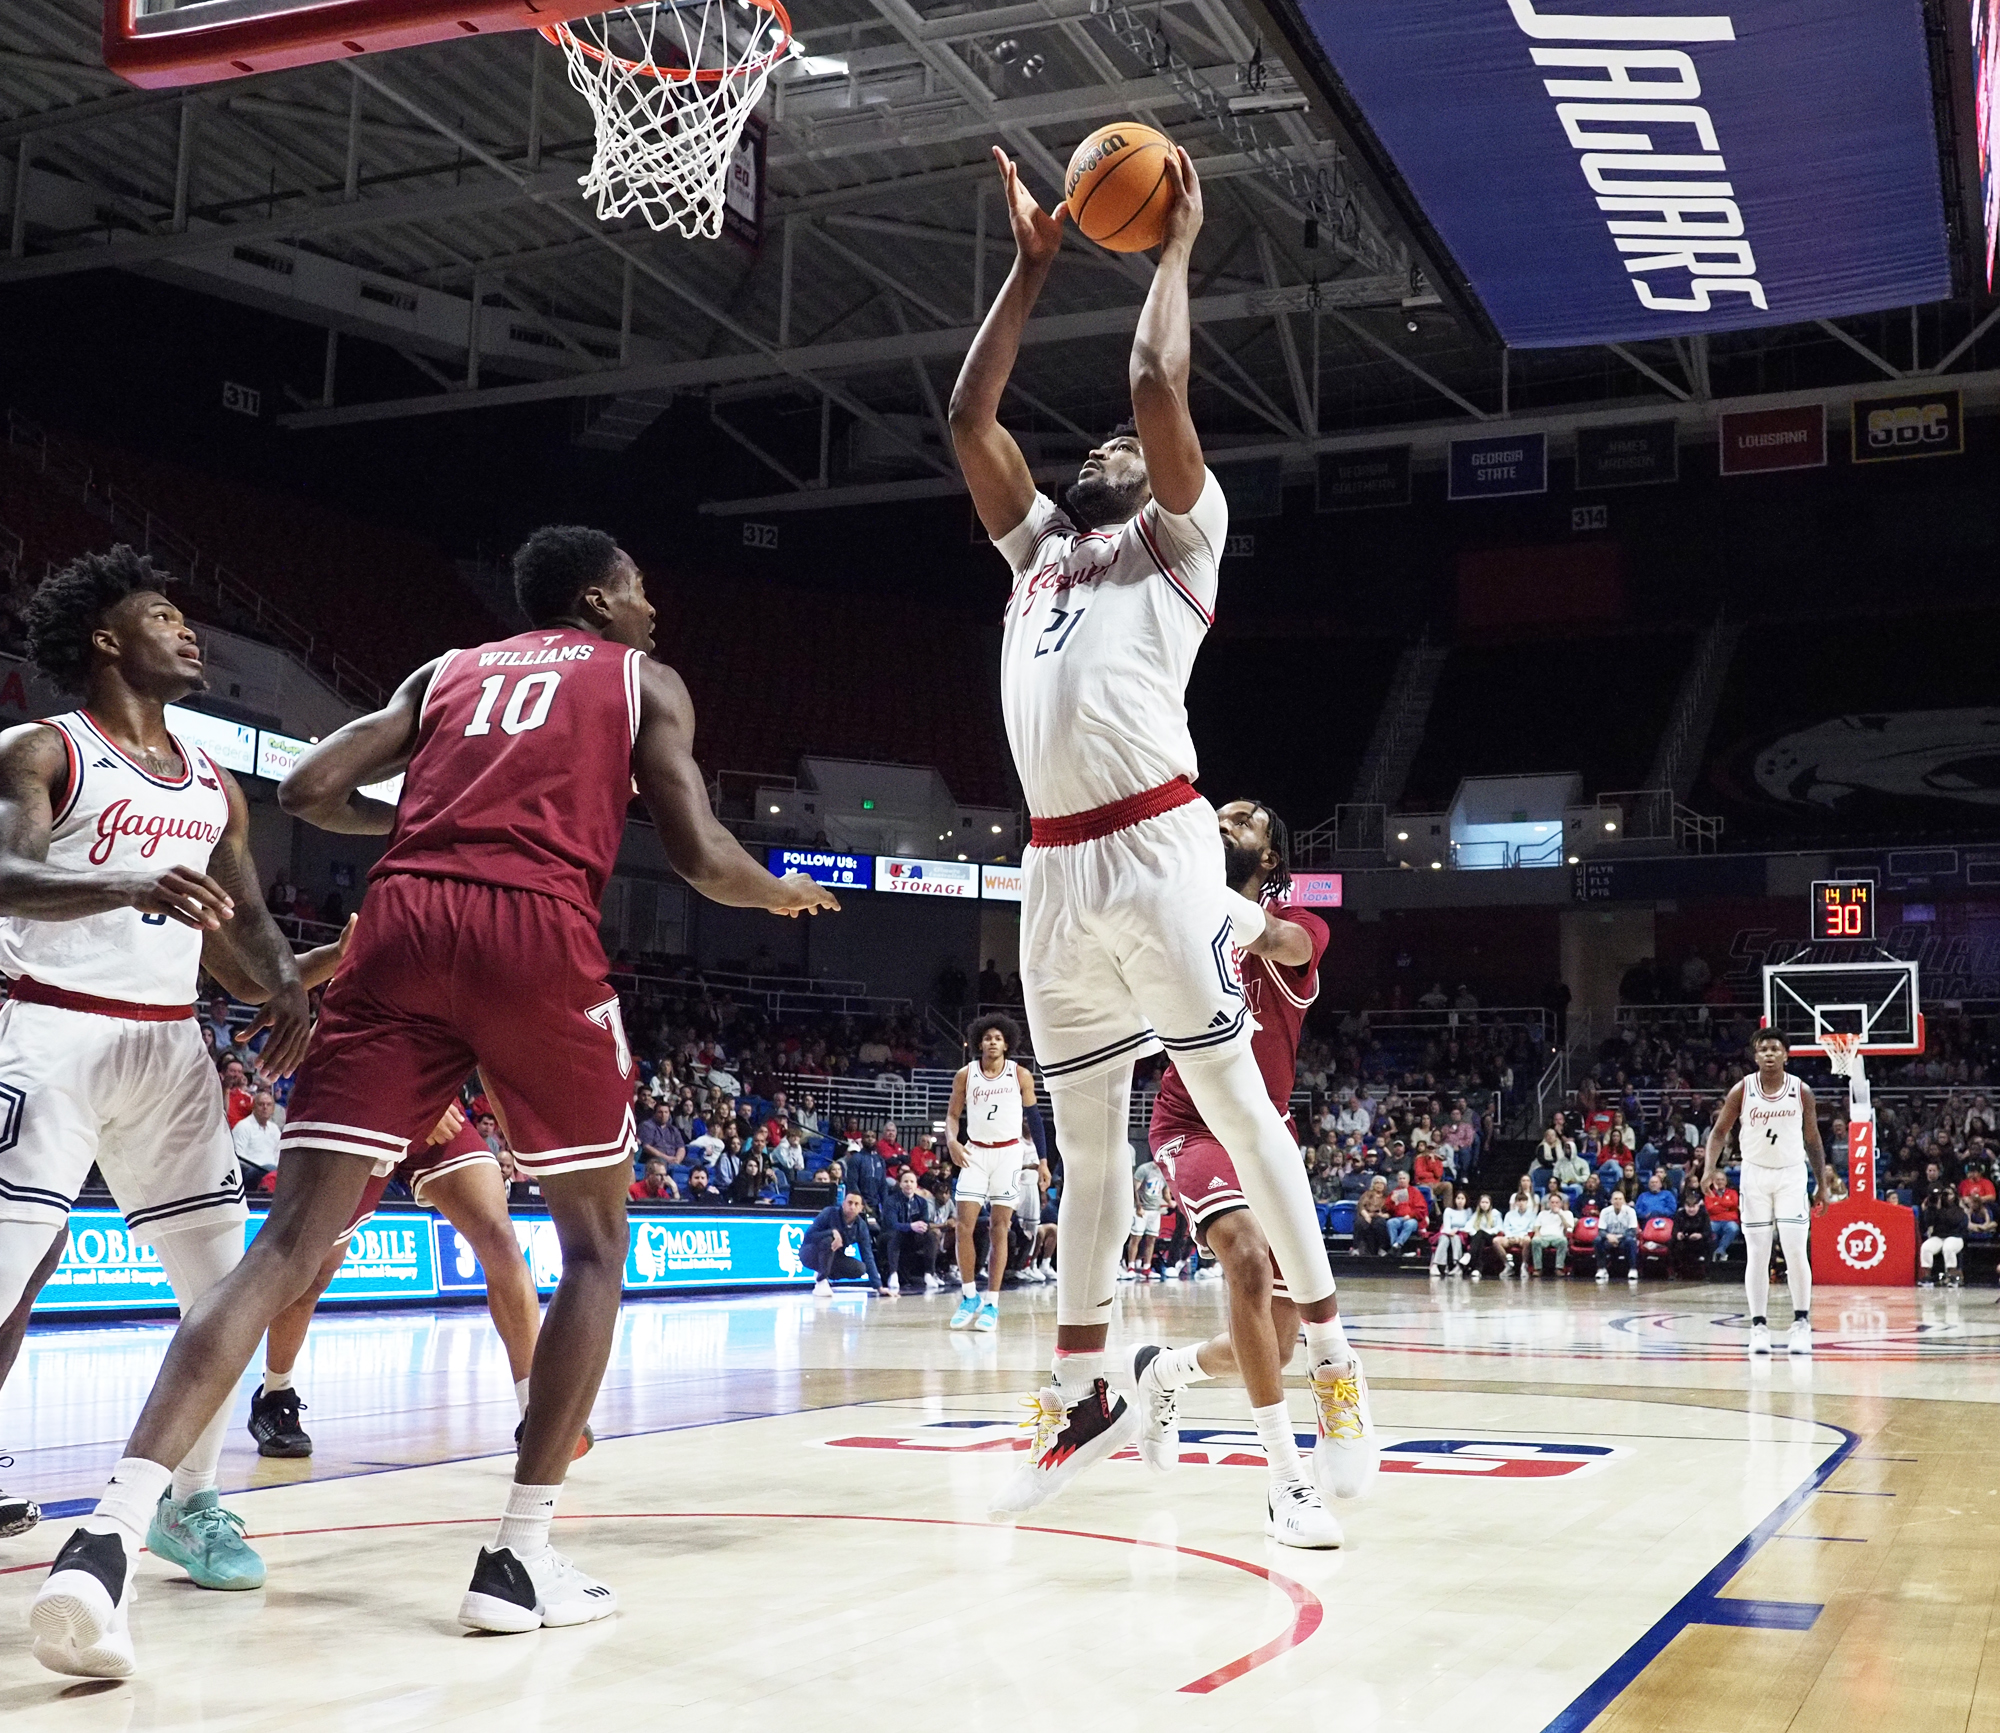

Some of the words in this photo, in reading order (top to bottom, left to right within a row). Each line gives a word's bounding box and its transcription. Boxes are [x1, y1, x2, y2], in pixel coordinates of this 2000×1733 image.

[1508, 0, 1768, 312] JAGUARS
[226, 385, 259, 413] 311
[1868, 403, 1949, 448] SBC
[1738, 429, 1808, 449] LOUISIANA
[1471, 449, 1523, 466] GEORGIA
[1476, 466, 1517, 481] STATE
[1575, 508, 1606, 528] 314
[744, 525, 777, 546] 312
[1034, 607, 1086, 660] 21
[477, 644, 595, 668] WILLIAMS
[463, 670, 562, 738] 10
[88, 798, 221, 866] Jaguars
[783, 852, 834, 867] FOLLOW
[836, 855, 857, 869] US:
[1589, 865, 1614, 874] PLYR
[889, 863, 923, 879] USA
[890, 880, 964, 895] STORAGE
[1307, 881, 1332, 891] JOIN
[1825, 888, 1840, 904] 14
[1851, 887, 1867, 904] 14
[1826, 904, 1862, 934] 30
[972, 1086, 1013, 1105] Jaguars
[986, 1104, 998, 1121] 2
[1749, 1107, 1796, 1127] Jaguars
[1766, 1128, 1778, 1145] 4
[345, 1230, 418, 1260] OBILE
[667, 1229, 731, 1255] MOBILE
[1849, 1234, 1874, 1257] pf
